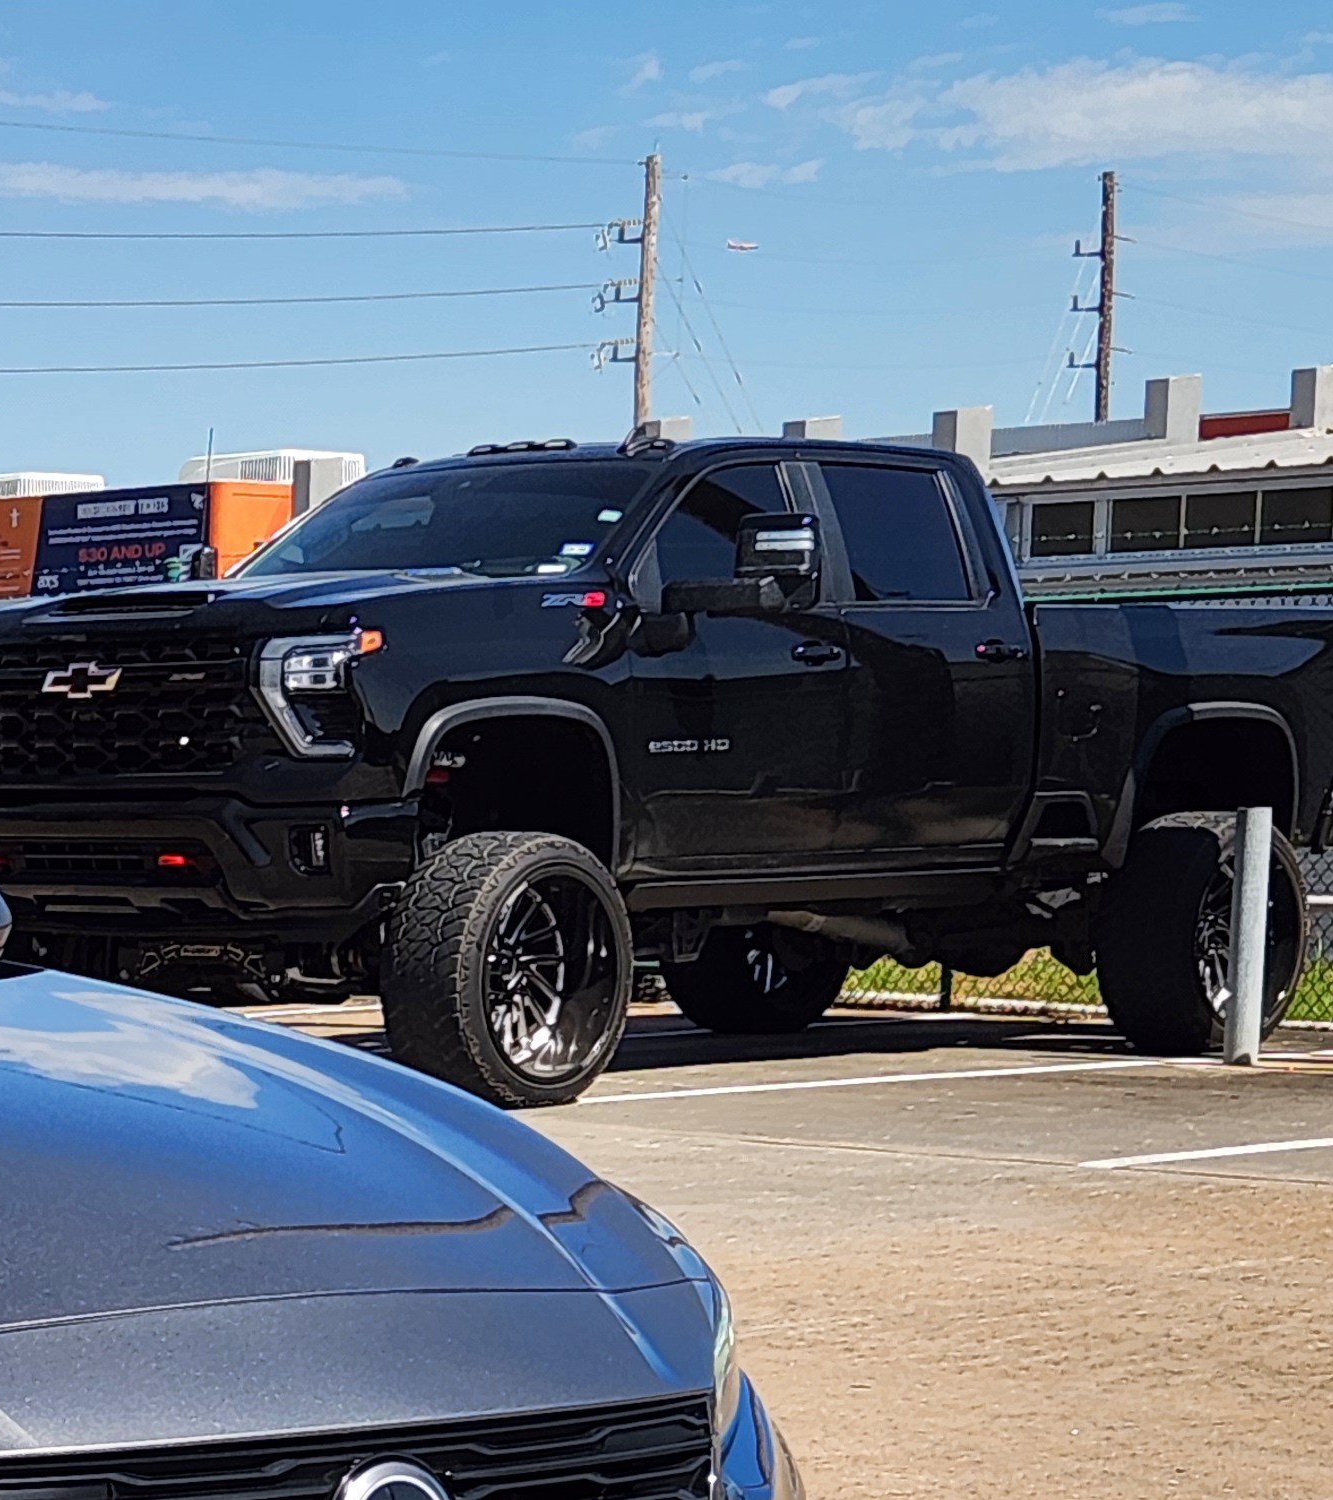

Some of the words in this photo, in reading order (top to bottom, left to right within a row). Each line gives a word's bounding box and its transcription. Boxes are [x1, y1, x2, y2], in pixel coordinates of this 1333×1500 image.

[78, 547, 108, 563] $30
[109, 544, 143, 561] AND
[144, 542, 166, 558] UP
[540, 591, 606, 607] ZR2
[648, 740, 699, 753] 2500
[703, 738, 730, 751] HD
